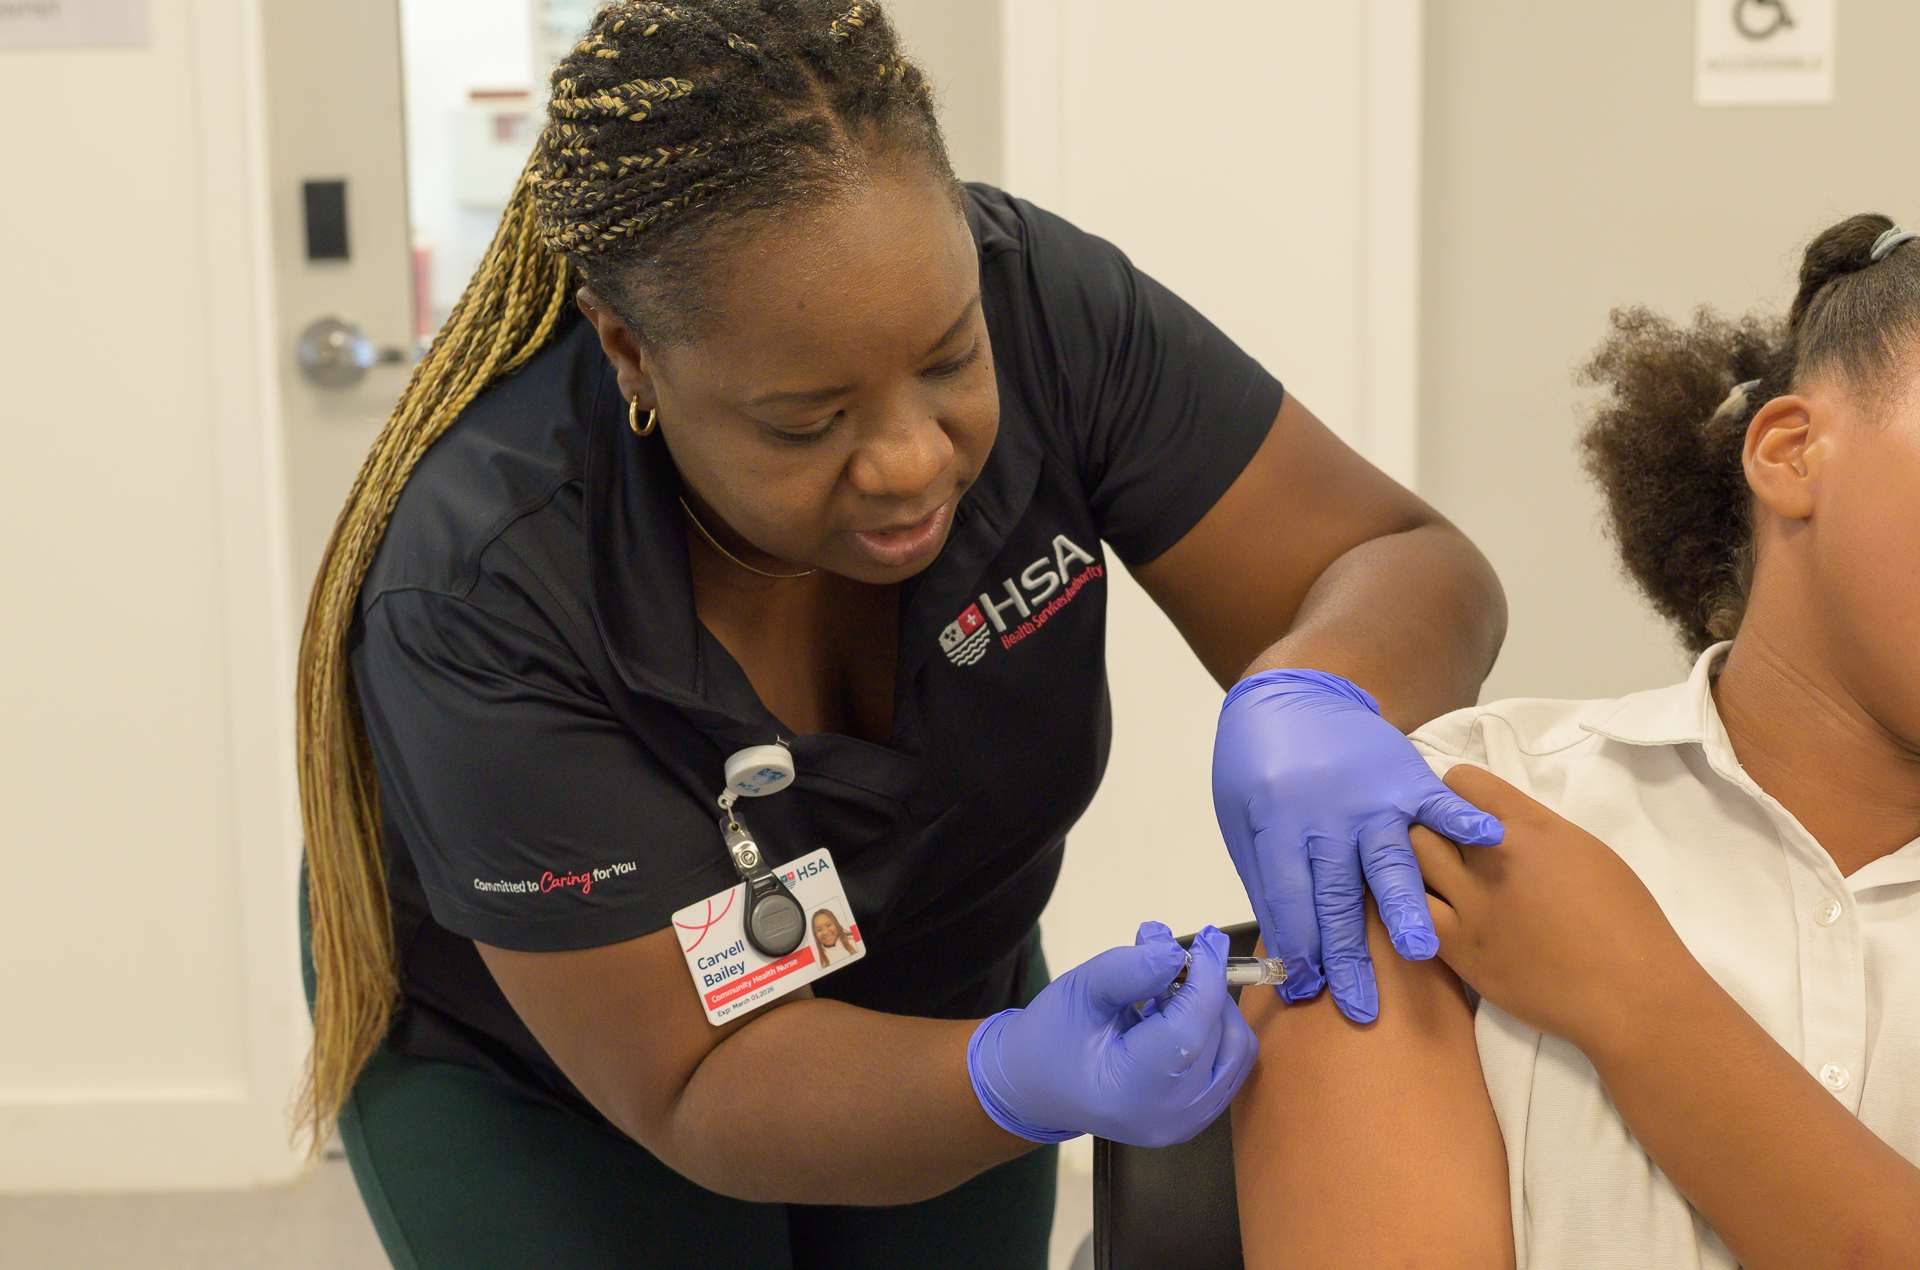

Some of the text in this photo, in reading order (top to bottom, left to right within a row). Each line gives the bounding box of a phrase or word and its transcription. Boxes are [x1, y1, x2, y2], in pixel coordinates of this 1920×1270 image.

[979, 534, 1095, 633] HSA
[1000, 564, 1103, 649] Health Services Authority
[474, 861, 637, 895] Committed to Caring for You
[796, 858, 830, 881] HSA
[697, 940, 745, 970] Carvell
[703, 961, 745, 987] Bailey
[711, 958, 798, 1003] Community Health Nurse
[717, 1007, 732, 1018] Exp:
[732, 997, 751, 1010] March
